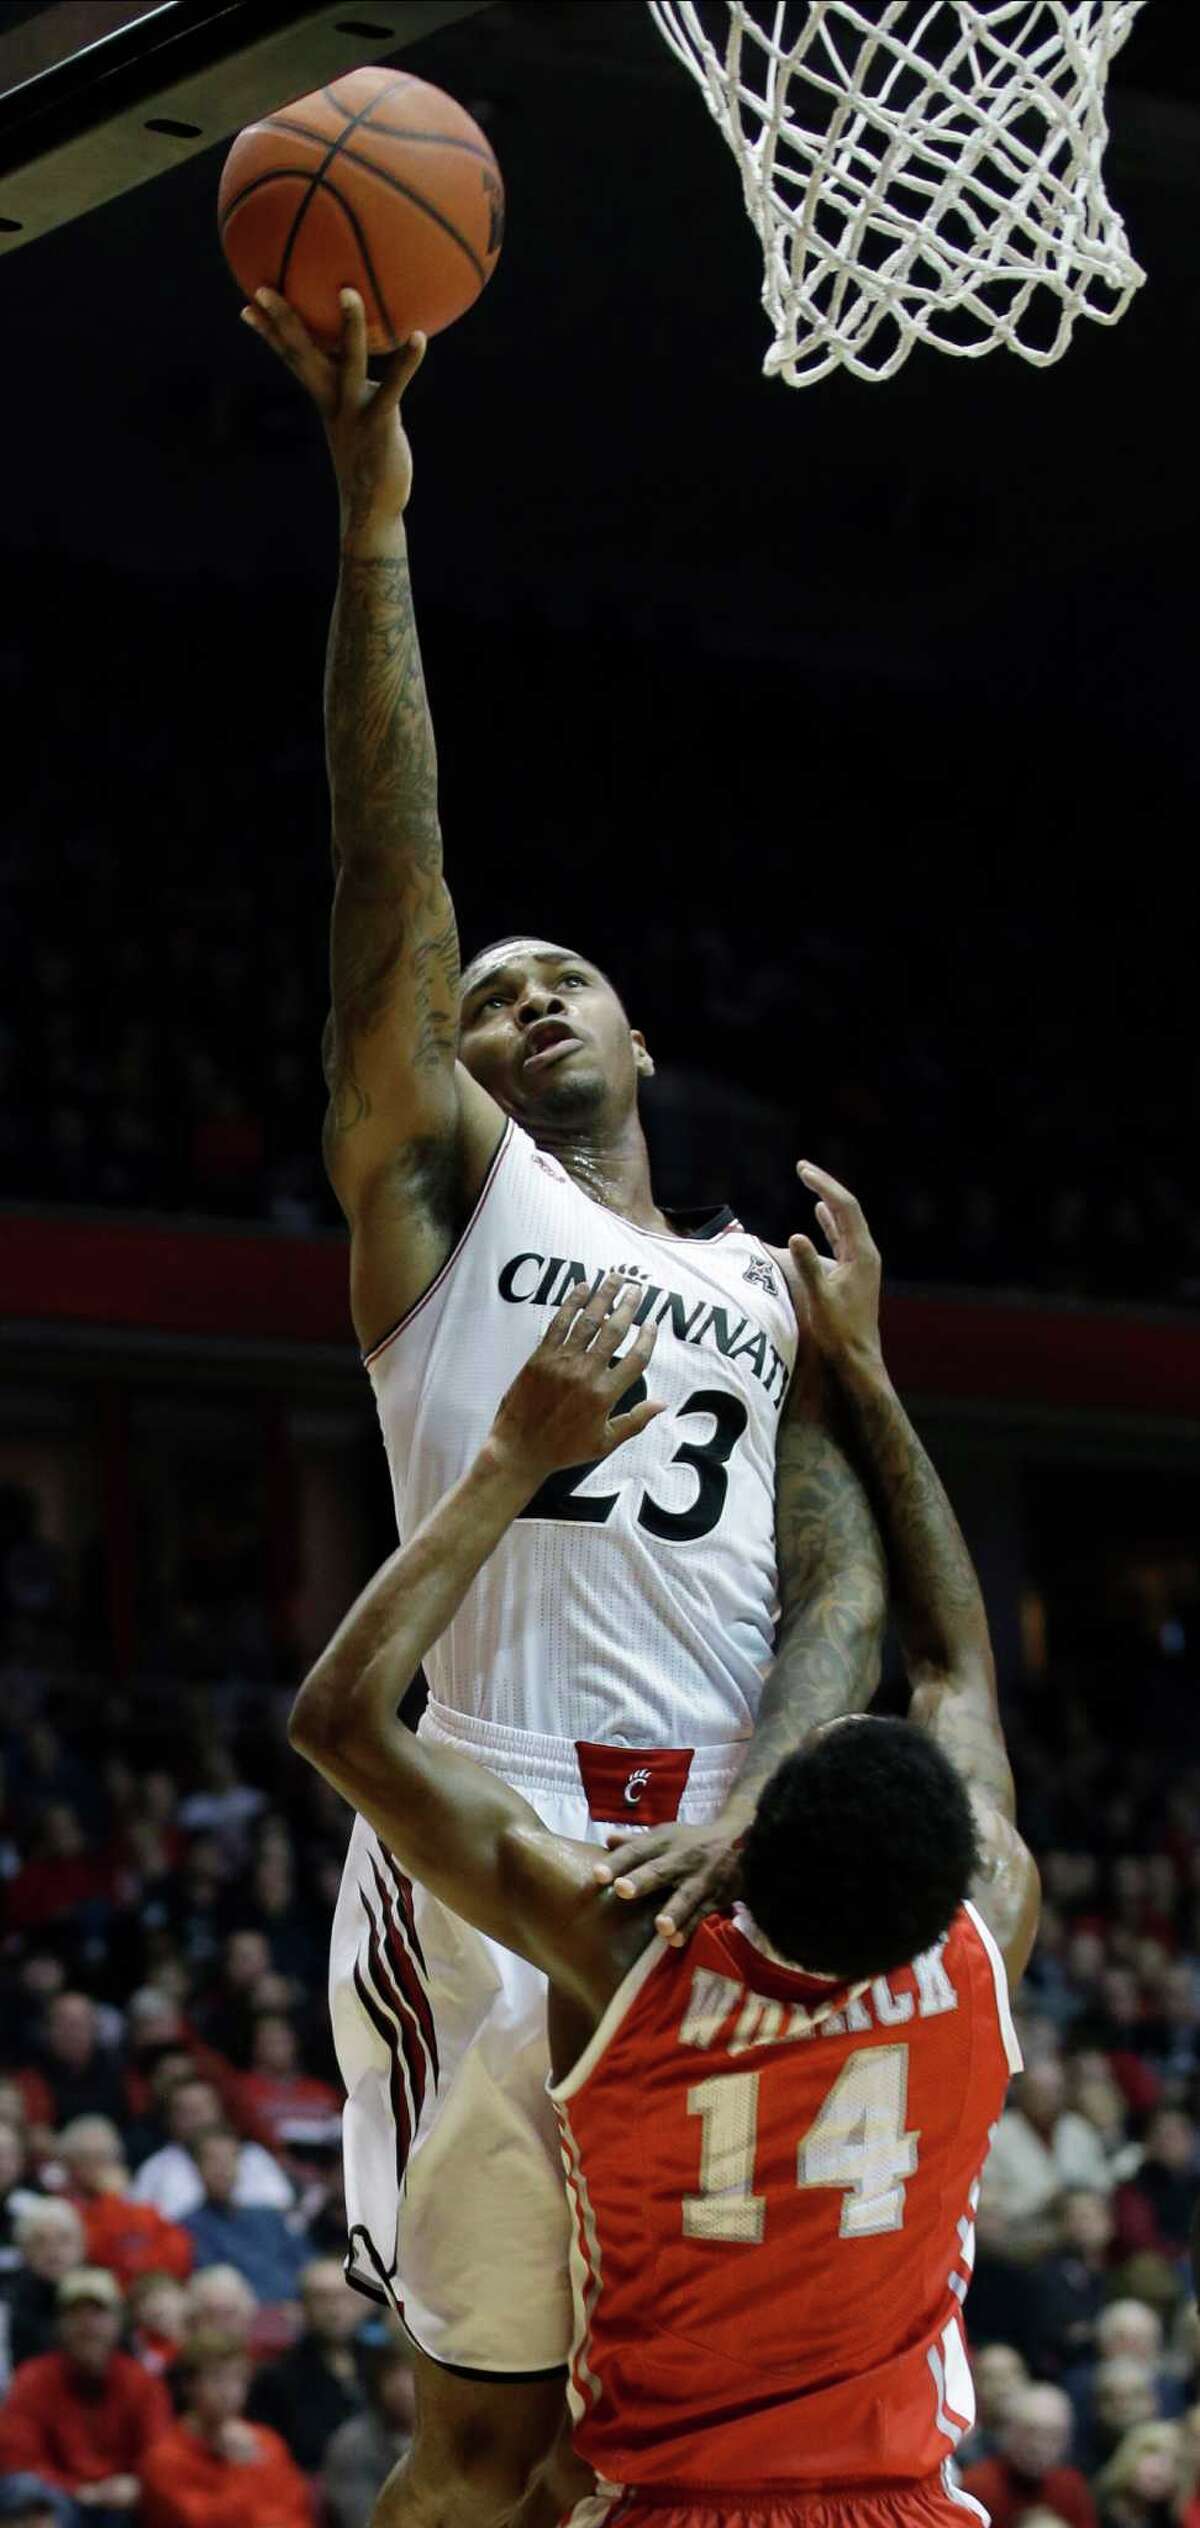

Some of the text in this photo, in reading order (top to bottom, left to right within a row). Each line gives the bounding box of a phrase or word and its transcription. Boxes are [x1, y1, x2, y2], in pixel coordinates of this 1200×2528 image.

[498, 1252, 789, 1411] CININNATI
[678, 1930, 958, 2057] WOCK
[682, 2043, 920, 2244] 14
